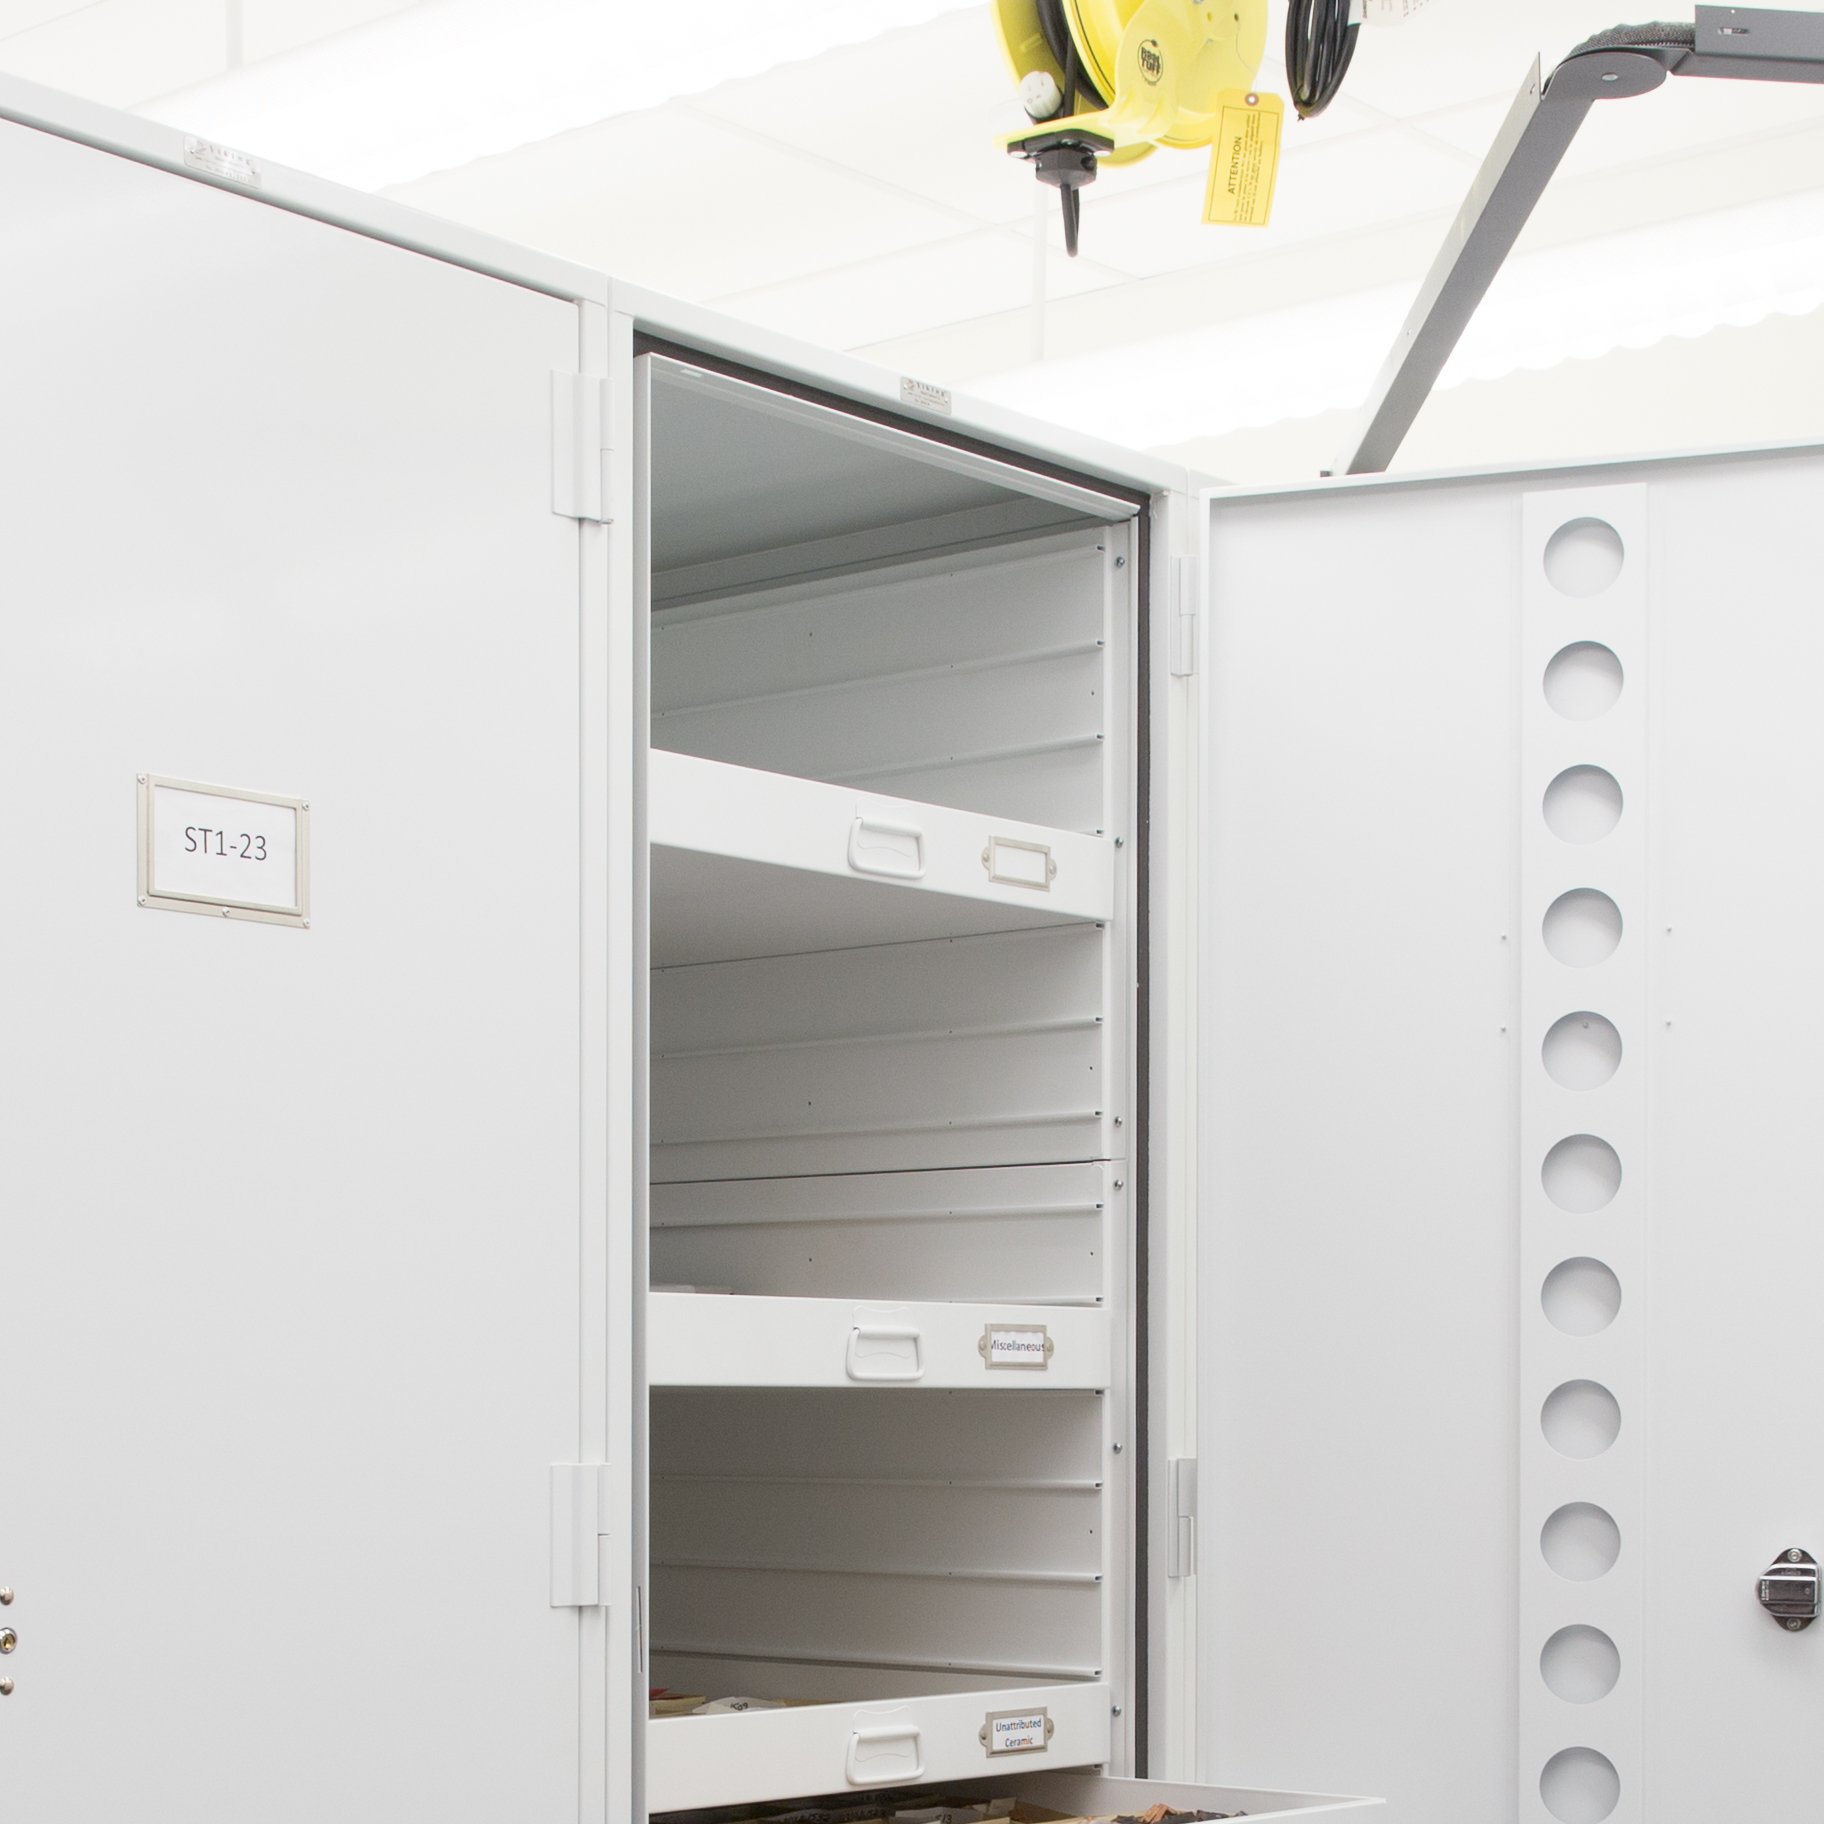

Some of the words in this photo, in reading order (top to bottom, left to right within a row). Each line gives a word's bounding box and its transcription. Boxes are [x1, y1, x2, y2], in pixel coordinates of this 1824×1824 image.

[1227, 136, 1242, 195] ATTENTION
[184, 826, 267, 861] ST1-23
[996, 1717, 1042, 1732] Unattributed
[1005, 1735, 1033, 1748] Ceramic
